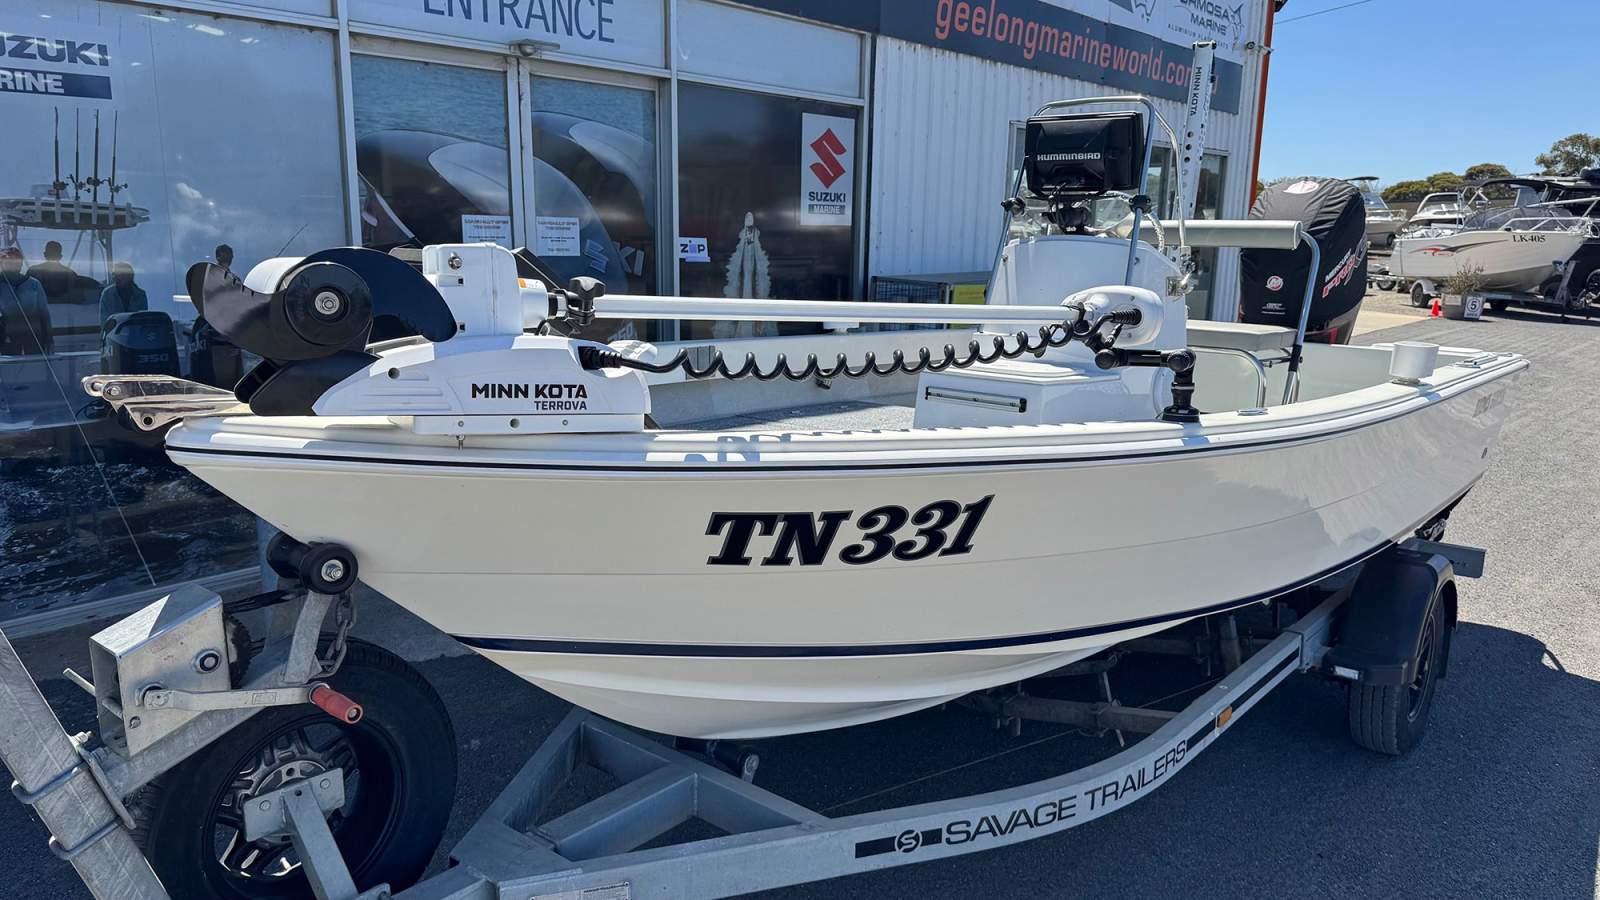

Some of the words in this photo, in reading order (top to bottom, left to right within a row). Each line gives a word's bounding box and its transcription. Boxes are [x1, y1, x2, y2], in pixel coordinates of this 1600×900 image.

[1191, 13, 1227, 36] MARINE
[0, 35, 110, 67] ZUKI
[1193, 66, 1202, 91] MINN
[1190, 92, 1200, 117] KOTA
[1036, 152, 1101, 161] HUMMINBIRD
[808, 191, 846, 203] SUZUKI
[813, 204, 840, 215] MARINE
[1470, 300, 1477, 310] 5
[471, 383, 529, 399] MINN
[534, 383, 588, 399] KOTA
[534, 400, 587, 411] TERROVA
[945, 795, 1077, 845] SAVAGE
[1084, 739, 1188, 811] TRAILERS
